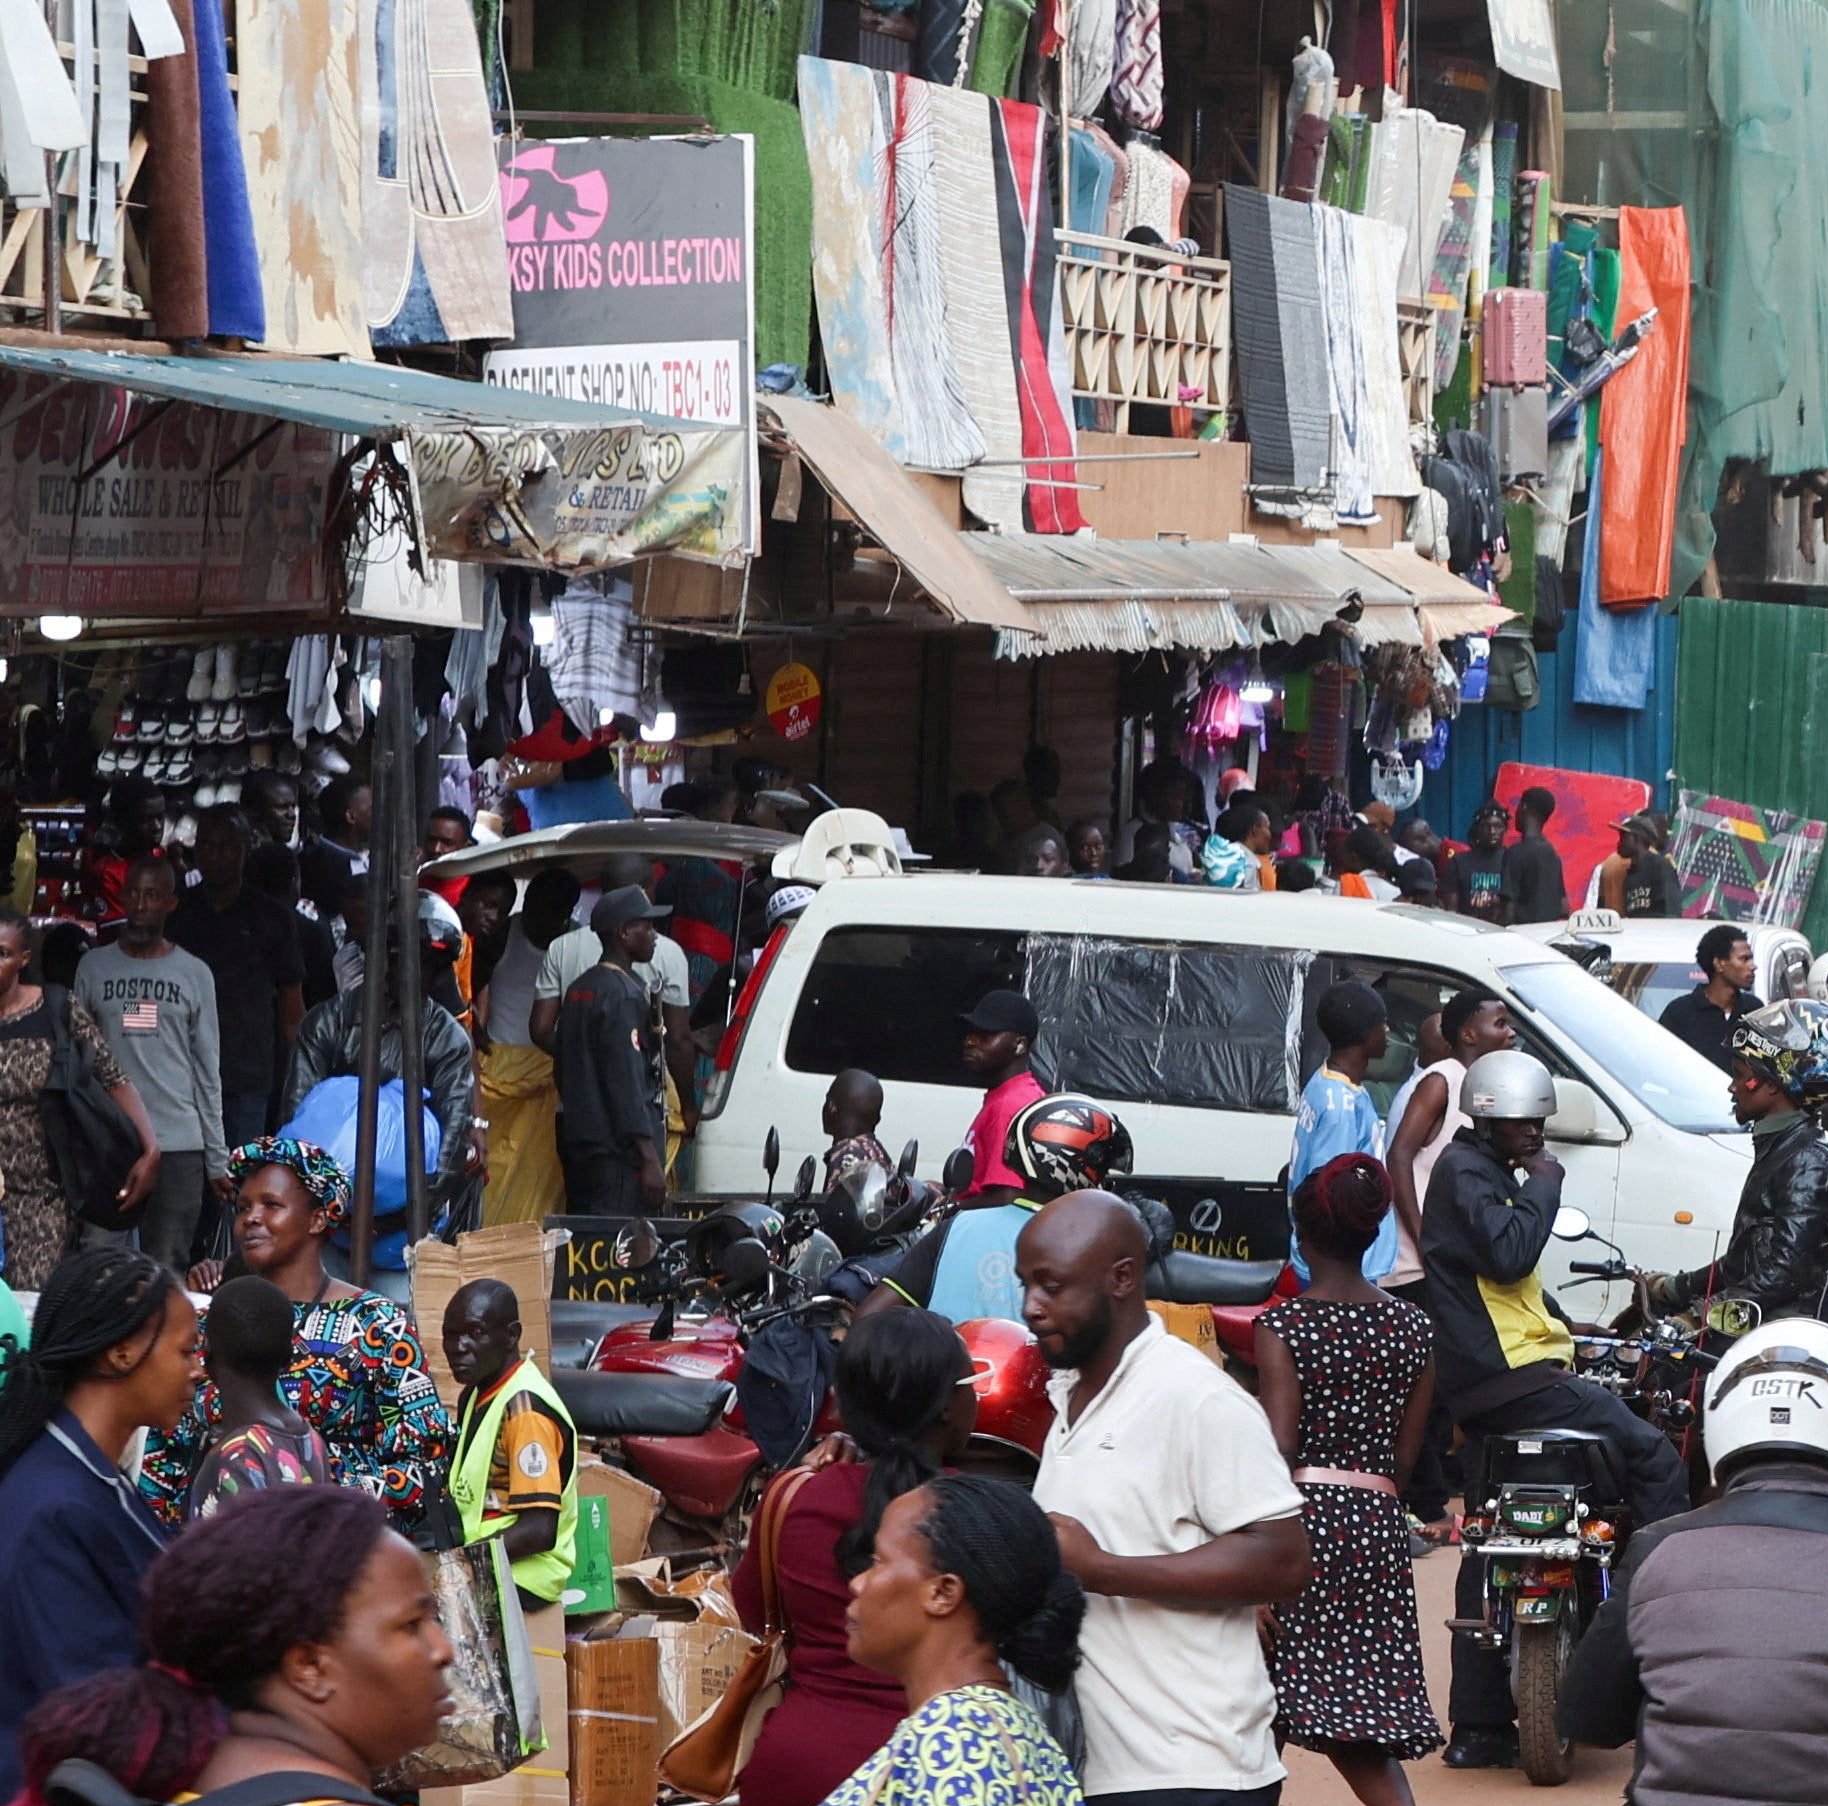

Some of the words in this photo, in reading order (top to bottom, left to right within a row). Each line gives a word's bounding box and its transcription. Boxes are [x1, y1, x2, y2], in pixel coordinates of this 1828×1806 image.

[554, 243, 602, 290] KIDS
[608, 238, 742, 287] COLLECTION
[110, 479, 155, 518] SALE
[785, 715, 811, 737] airtel
[1575, 914, 1616, 928] TAXI
[103, 978, 181, 1004] BOSTON
[1749, 1033, 1782, 1057] DESTROY
